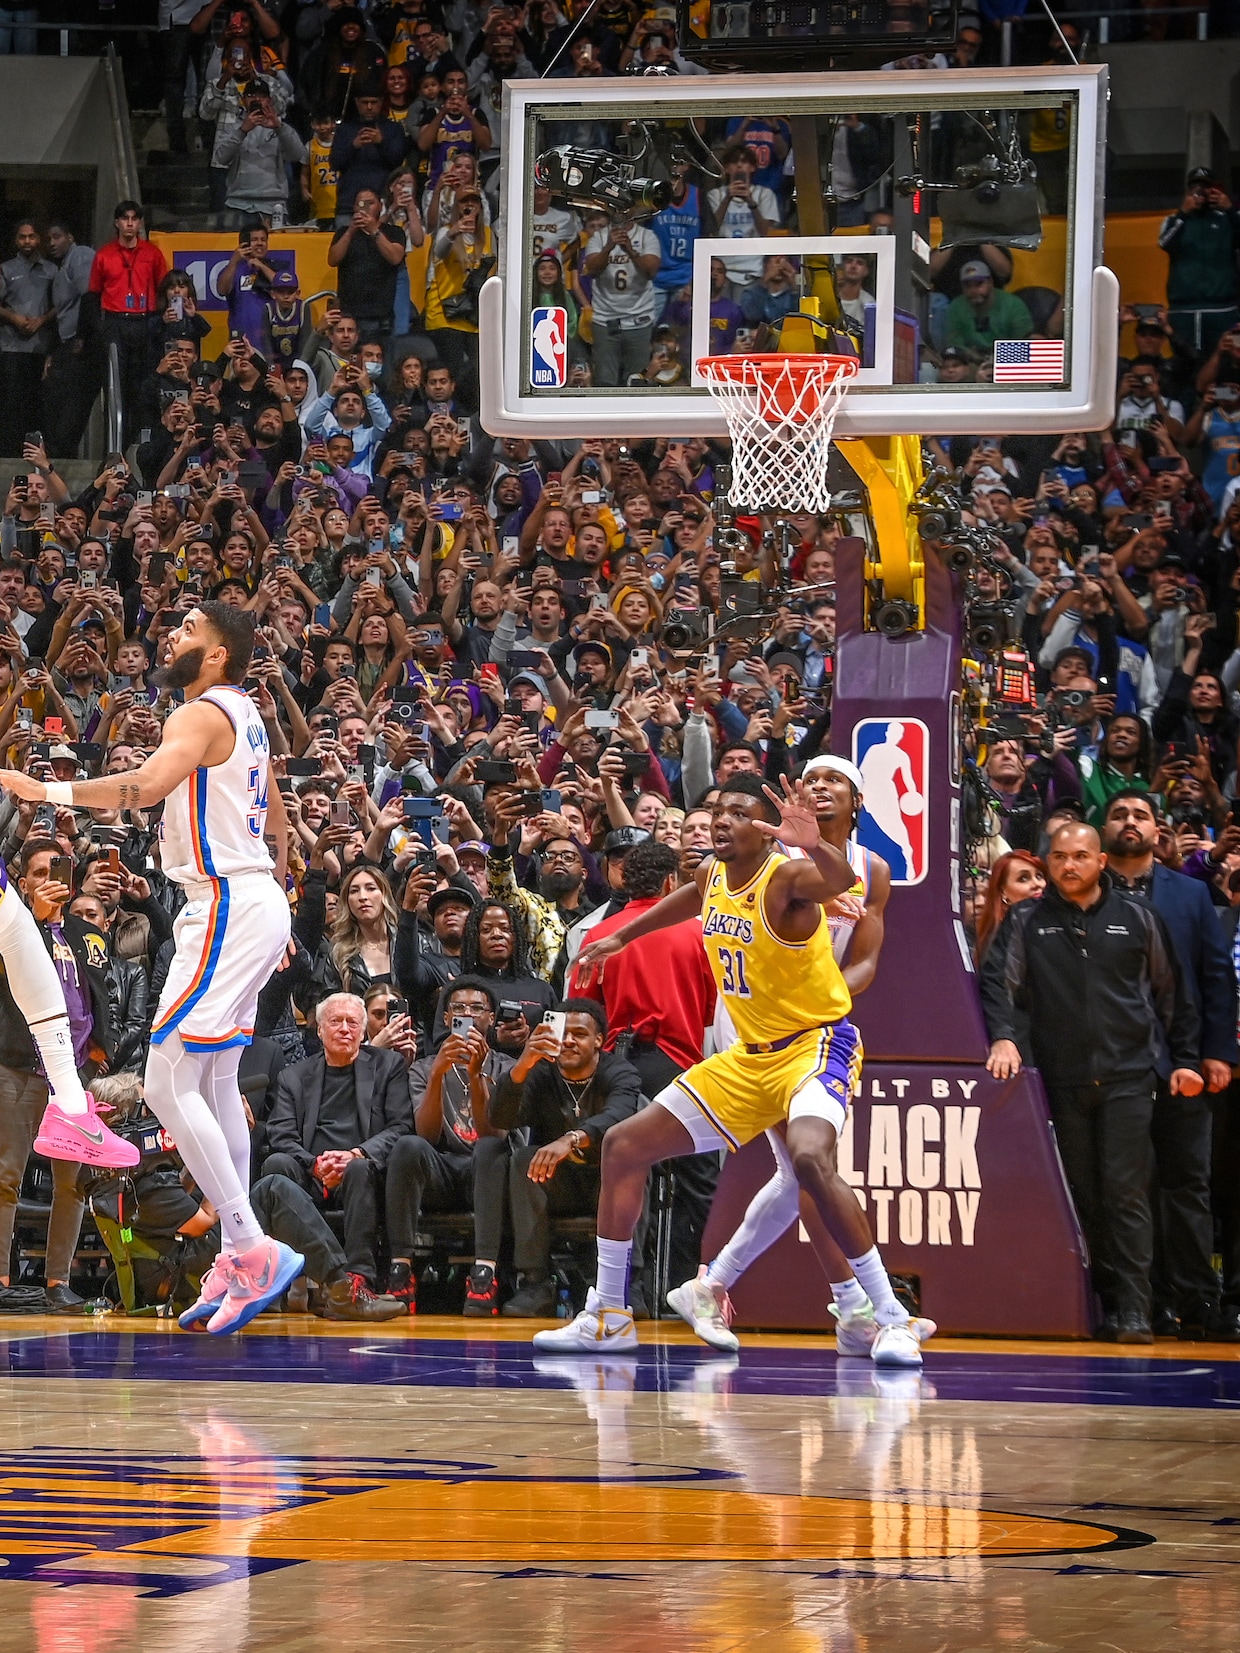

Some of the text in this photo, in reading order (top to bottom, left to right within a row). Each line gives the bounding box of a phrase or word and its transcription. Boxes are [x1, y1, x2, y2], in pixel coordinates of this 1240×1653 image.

[533, 224, 557, 233] KERS
[656, 214, 699, 227] OKLAHOMA
[533, 236, 544, 257] 6
[669, 238, 687, 258] 12
[608, 254, 630, 265] AKER
[614, 269, 628, 291] 6
[535, 370, 553, 383] NBA
[703, 906, 753, 944] LAKERS
[718, 947, 752, 998] 31
[854, 1079, 978, 1099] ILT BY
[836, 1104, 982, 1189] LACK
[798, 1189, 981, 1246] TORY
